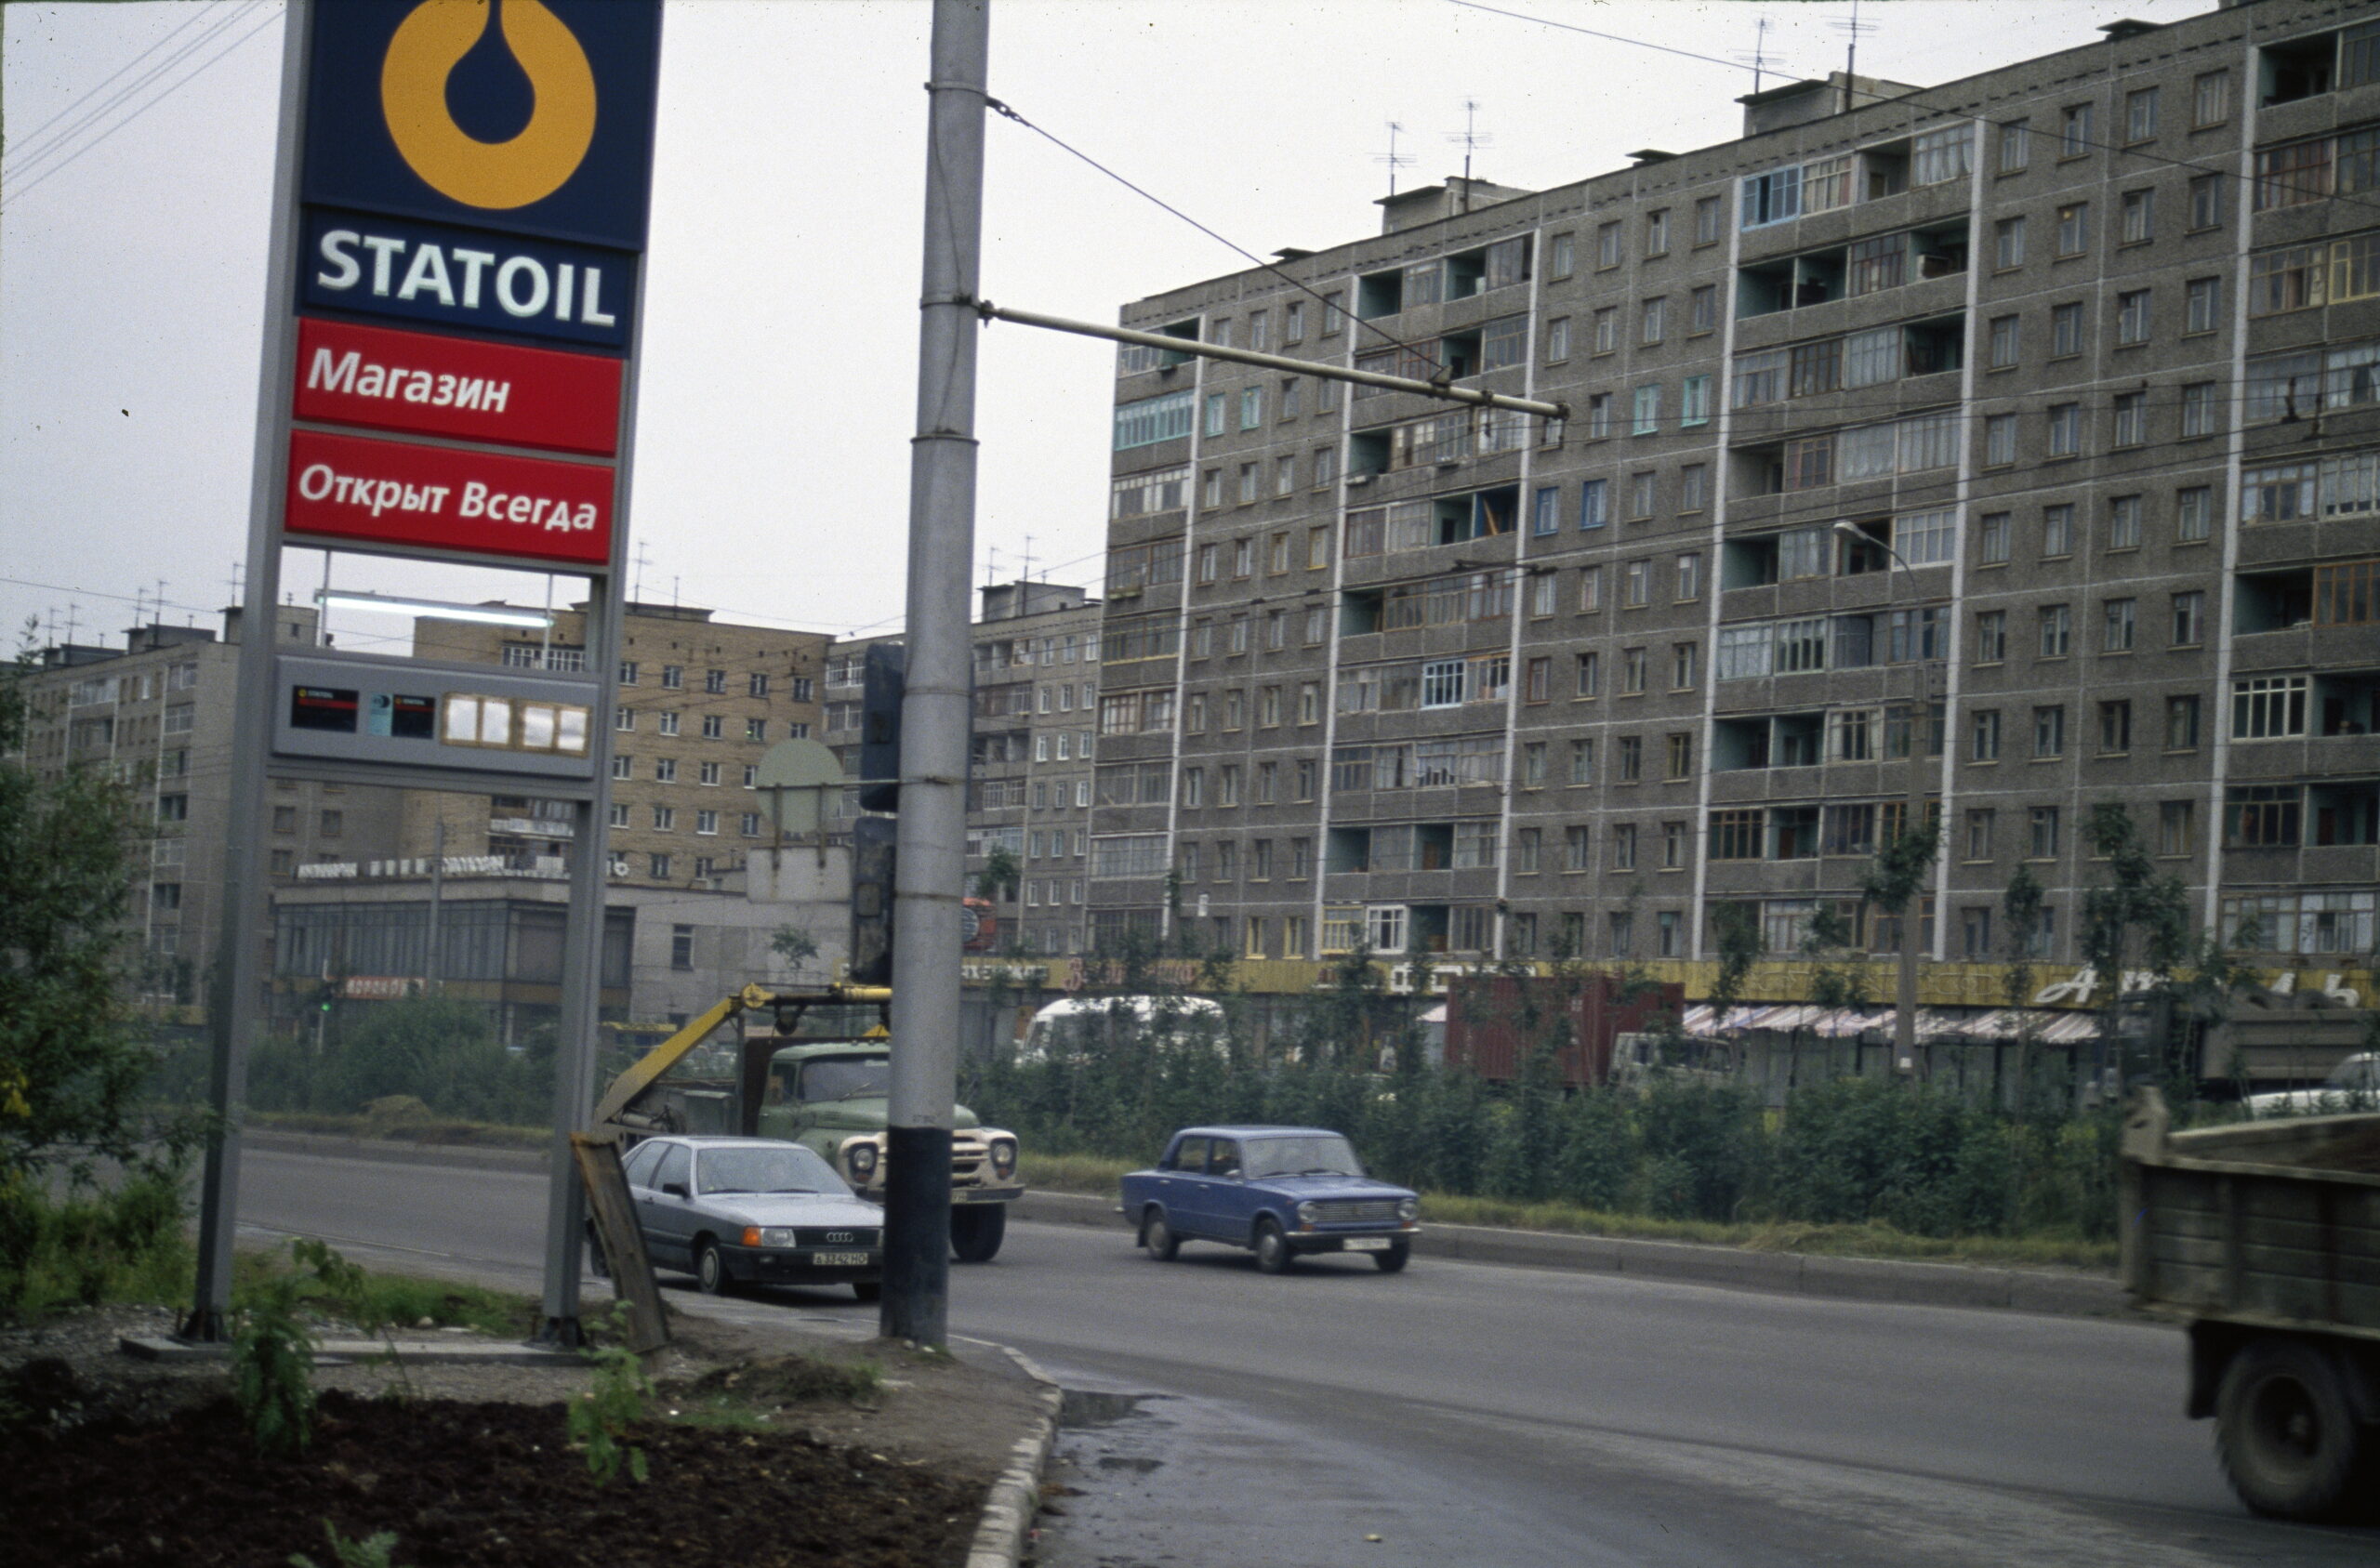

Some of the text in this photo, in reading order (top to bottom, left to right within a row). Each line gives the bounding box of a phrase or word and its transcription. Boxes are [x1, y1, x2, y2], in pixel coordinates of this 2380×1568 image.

[318, 230, 615, 326] STATOIL
[307, 348, 510, 413] Магазин
[299, 464, 598, 533] Открыт Всегда
